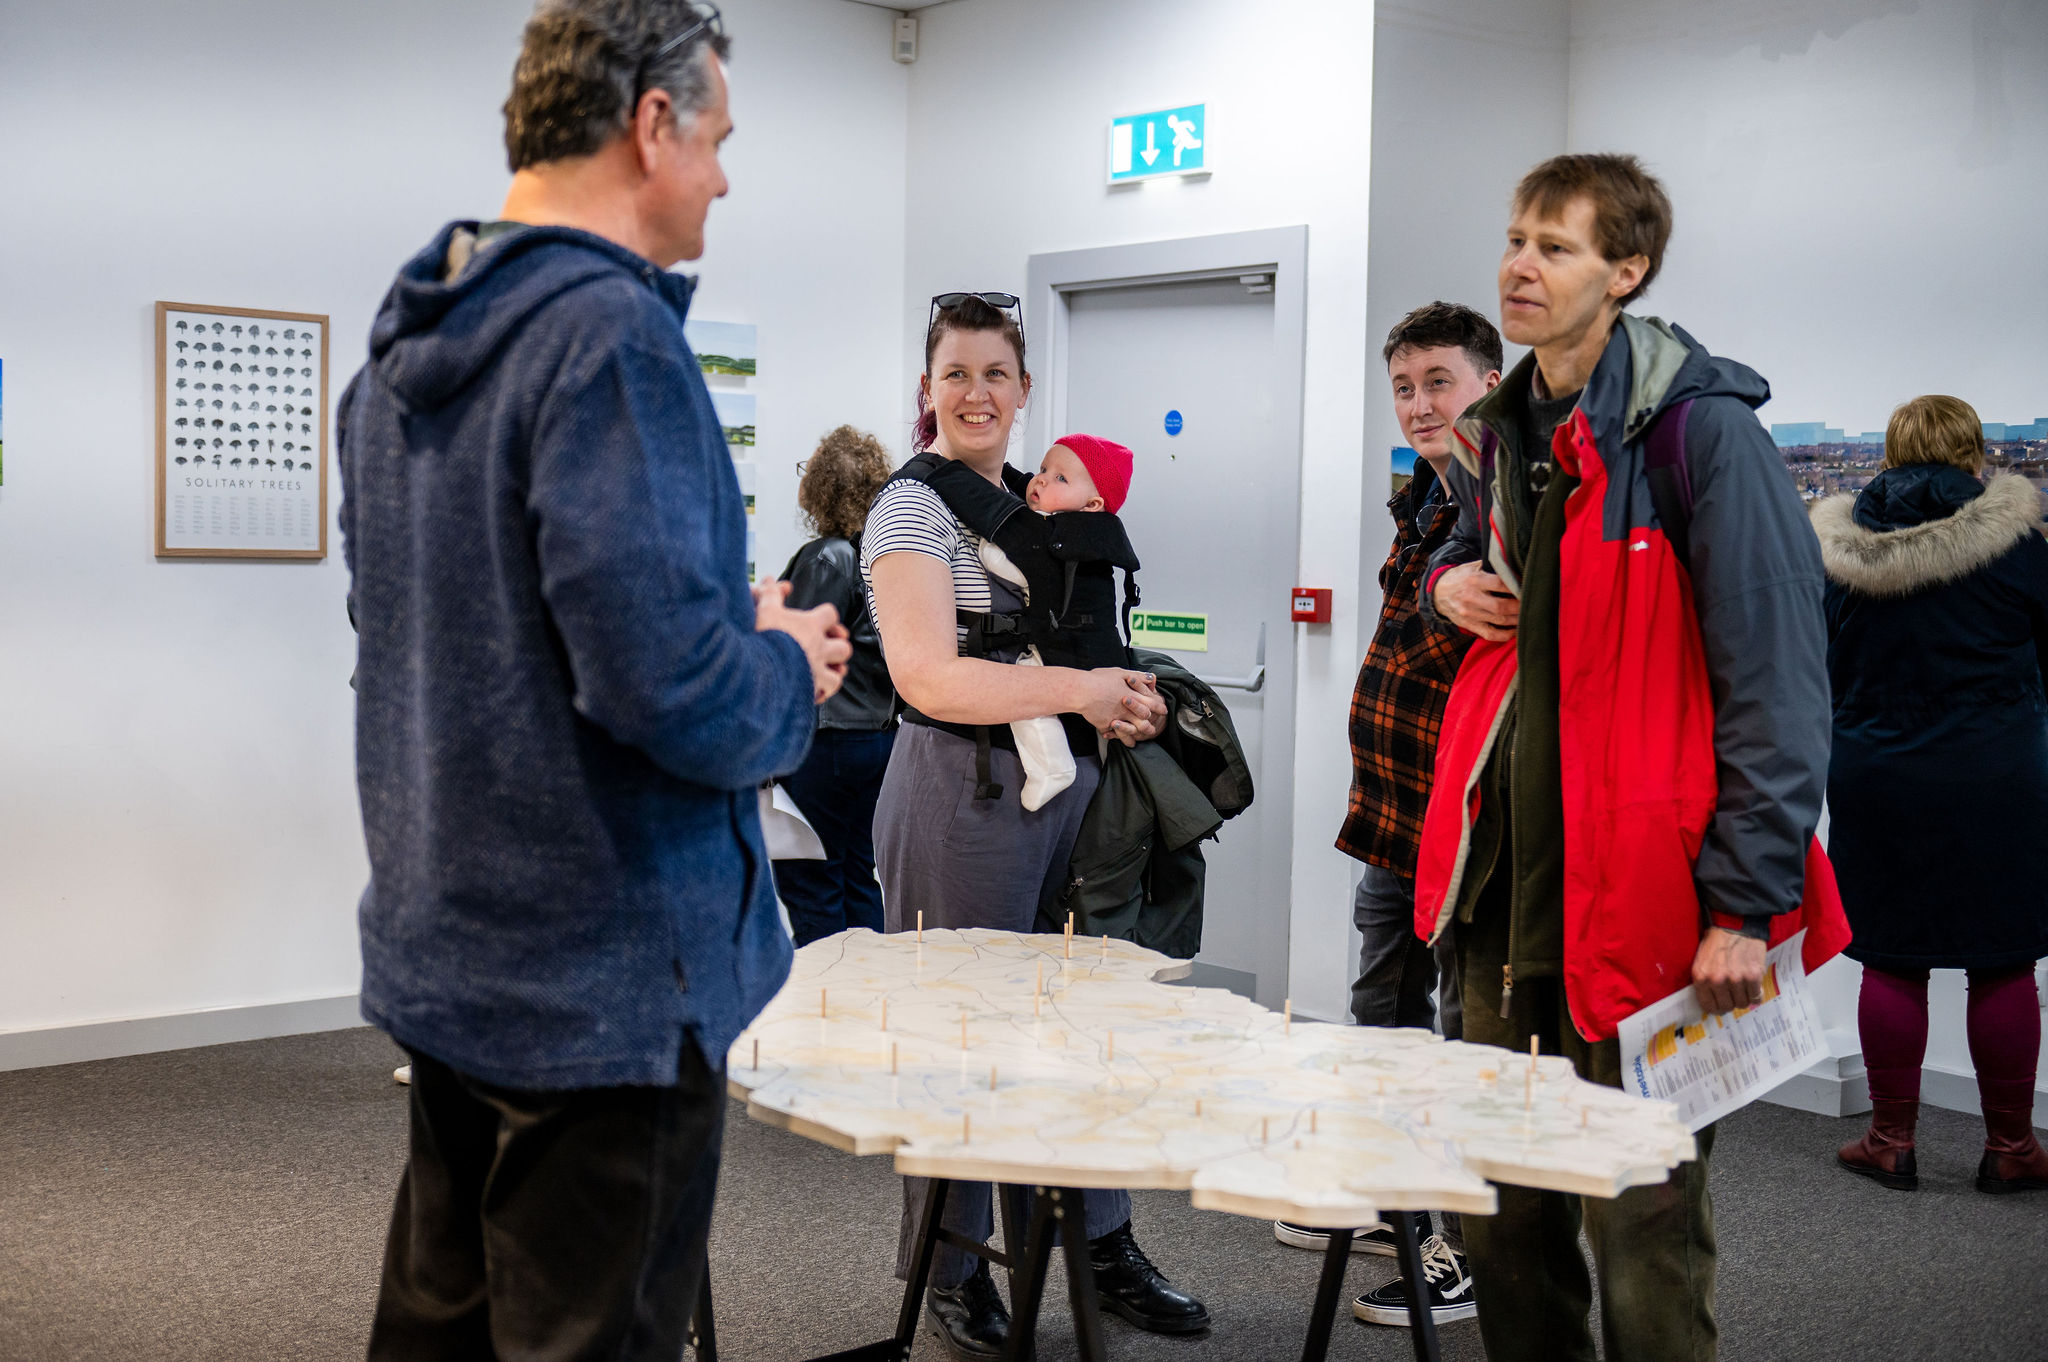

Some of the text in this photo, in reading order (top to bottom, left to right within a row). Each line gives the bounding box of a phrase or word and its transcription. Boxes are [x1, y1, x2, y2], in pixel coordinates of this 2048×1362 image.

[185, 477, 302, 490] SOLITARY TREES
[1147, 618, 1163, 627] Push
[1164, 619, 1176, 628] bar
[1633, 1055, 1650, 1098] metable
